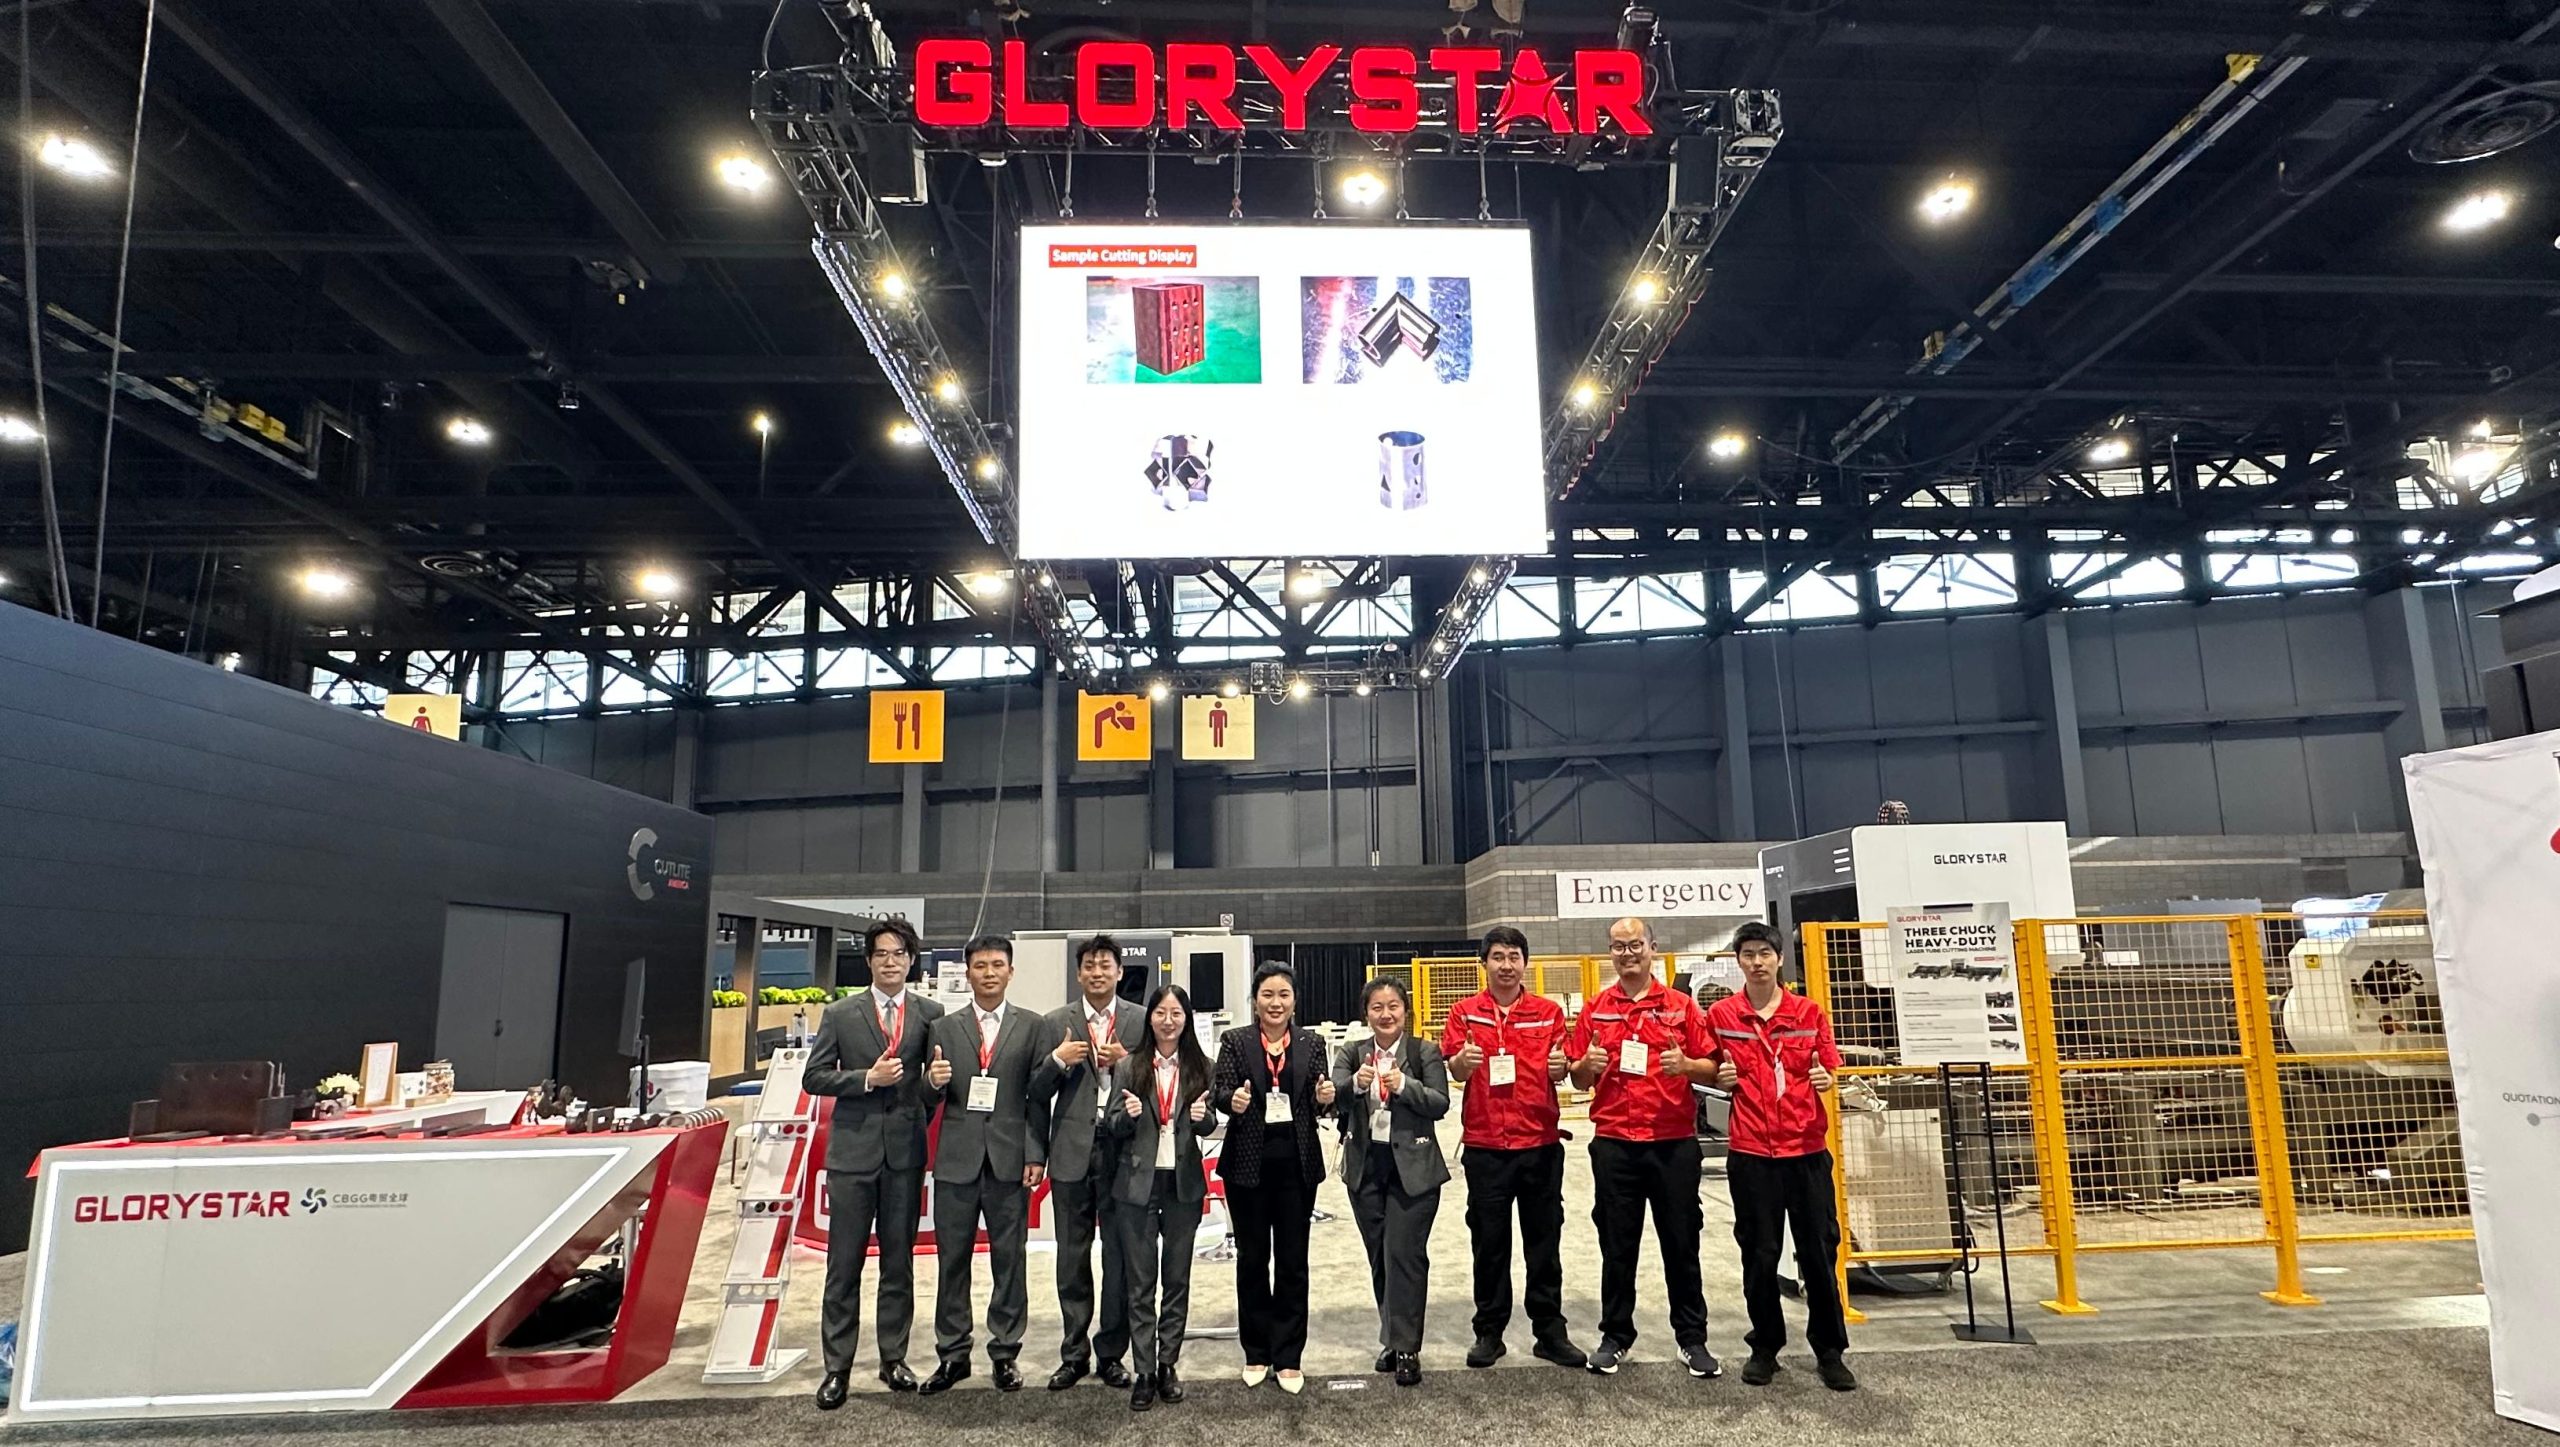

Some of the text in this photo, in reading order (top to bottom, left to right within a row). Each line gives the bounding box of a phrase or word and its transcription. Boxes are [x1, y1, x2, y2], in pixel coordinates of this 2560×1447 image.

[914, 38, 1654, 135] GLORYSTAR
[1052, 249, 1194, 265] Sample Cutting Display
[1933, 852, 2007, 865] GLORYSTAR
[1572, 878, 1753, 910] Emergency
[1896, 914, 1941, 923] GLORYSTAR
[1904, 925, 1996, 937] THREE CHUCK
[1905, 936, 1997, 948] HEAVY-DUTY
[75, 1191, 290, 1223] GLORYSTAR
